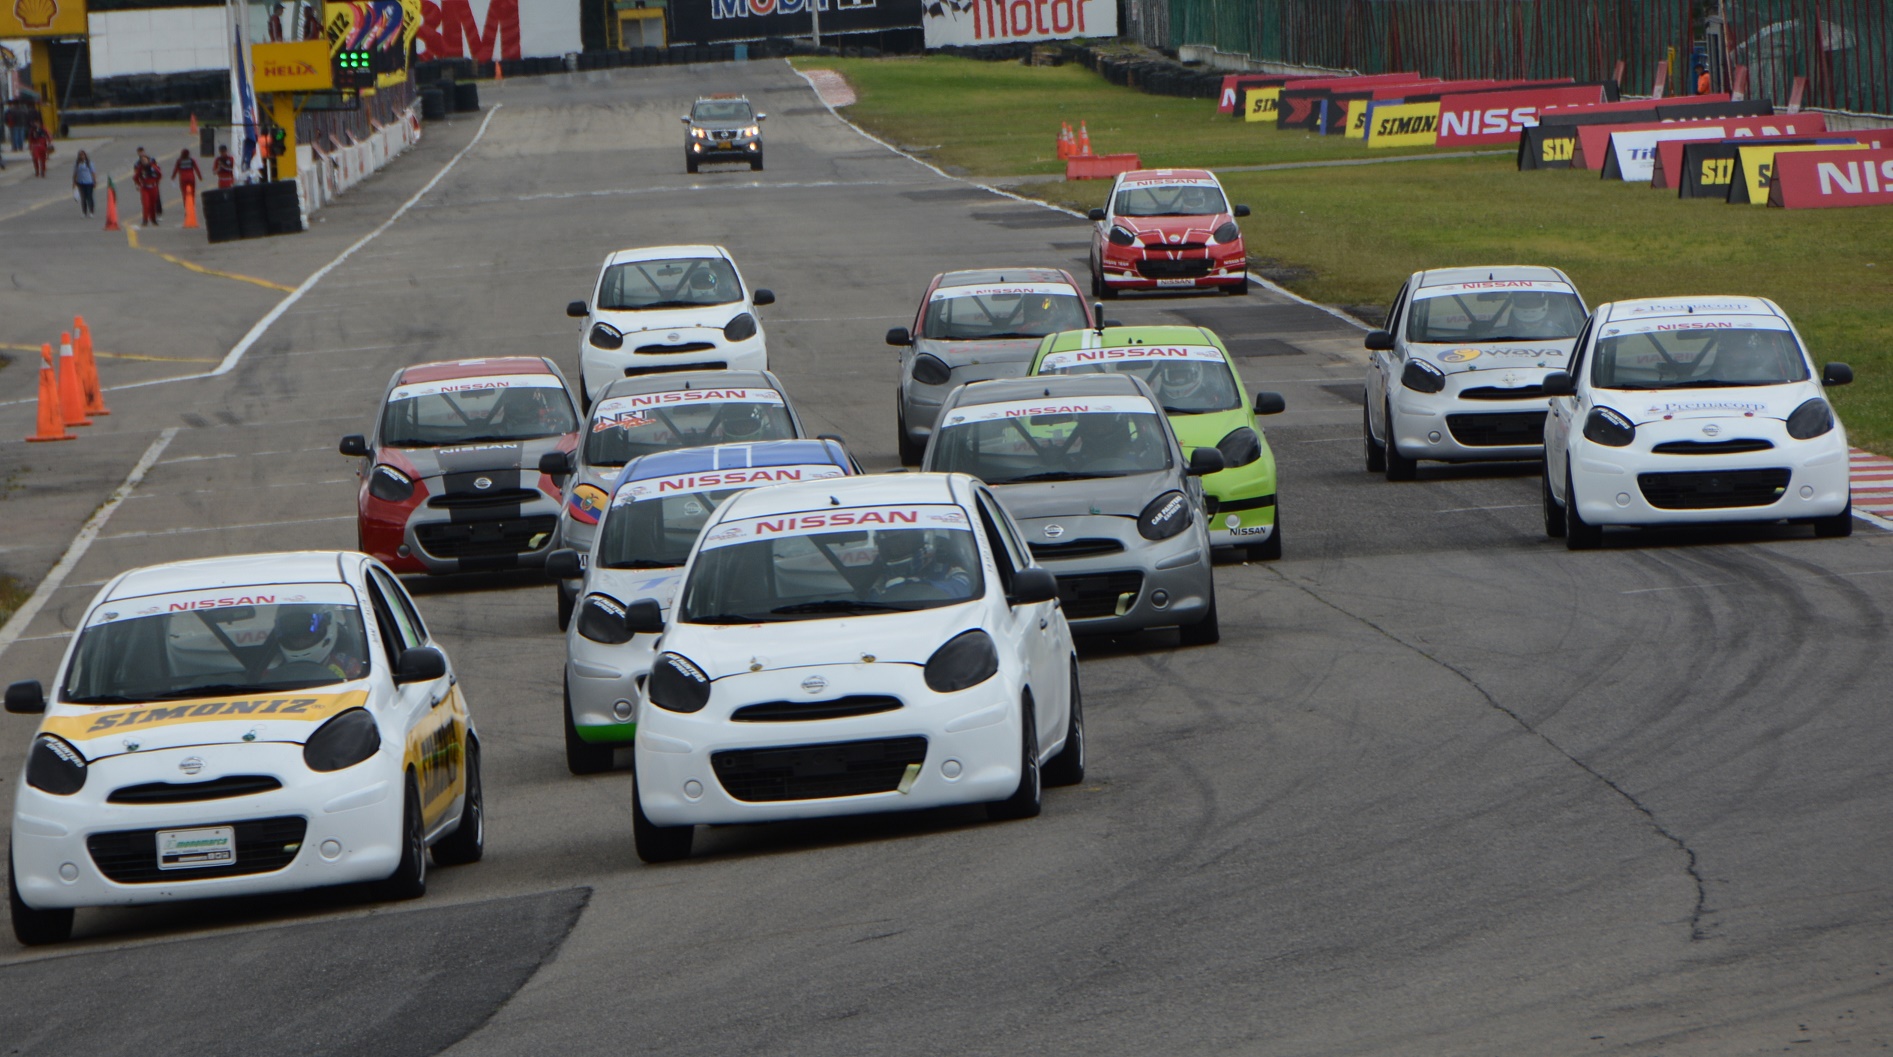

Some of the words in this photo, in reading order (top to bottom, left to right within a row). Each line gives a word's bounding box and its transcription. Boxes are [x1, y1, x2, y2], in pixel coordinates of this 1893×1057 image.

[264, 61, 317, 77] HELIX
[1136, 178, 1198, 187] NISSAN
[1462, 280, 1533, 289] NISSAN
[1657, 322, 1732, 331] NISSAN
[1076, 348, 1188, 362] NISSAN
[440, 381, 510, 393] NISSAN
[631, 390, 748, 407] NISSAN
[1005, 405, 1089, 417] NISSAN
[439, 444, 518, 455] NISSAN
[659, 469, 801, 492] NISSAN
[755, 511, 918, 535] NISSAN
[1229, 526, 1267, 537] NISSAN
[169, 595, 275, 612] NISSAN
[86, 698, 318, 734] SIMONIZ
